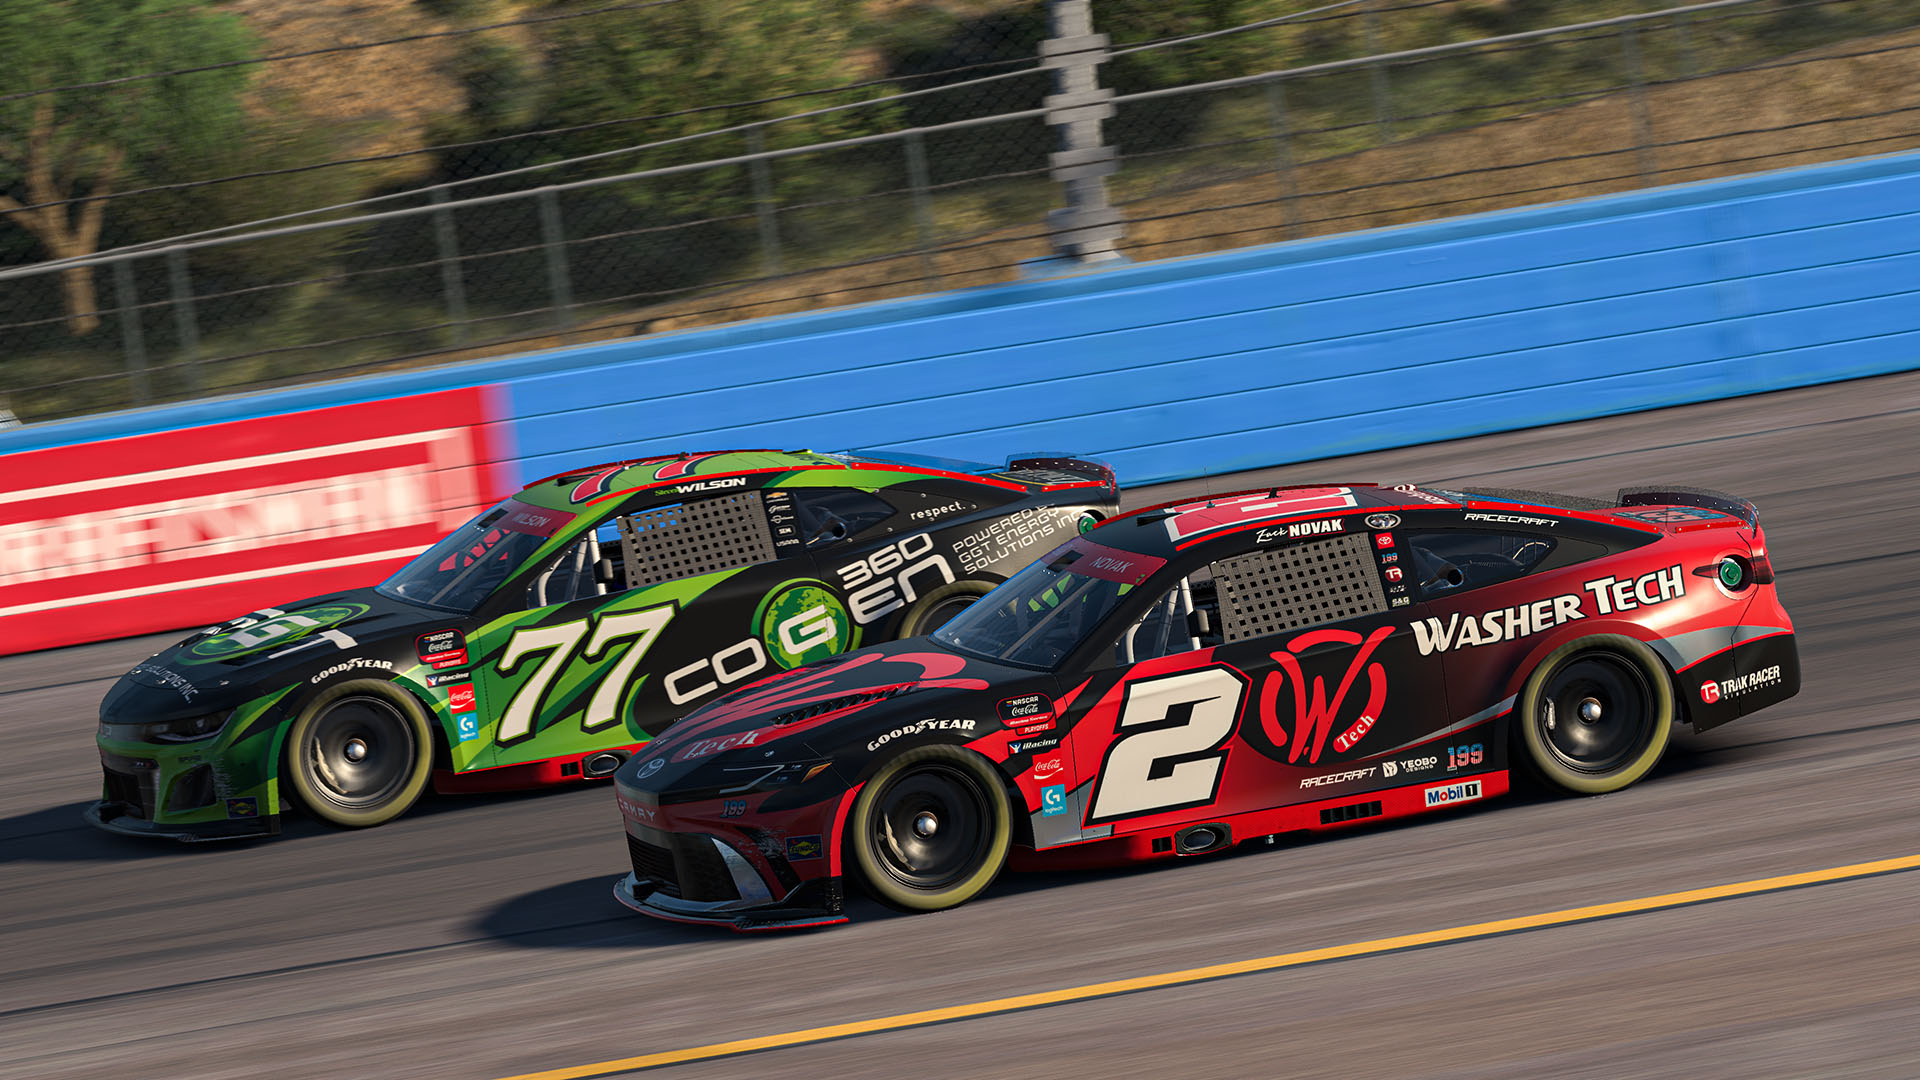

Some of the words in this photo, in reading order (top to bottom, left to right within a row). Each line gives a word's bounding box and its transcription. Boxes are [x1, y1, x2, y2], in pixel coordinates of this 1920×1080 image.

[676, 477, 747, 494] WILSON
[910, 501, 966, 520] respect.
[1464, 513, 1559, 528] RACECRAFT
[952, 508, 1033, 553] POWERED
[958, 540, 991, 564] GGT
[995, 507, 1059, 545] ENERGY
[1256, 527, 1288, 544] Zack
[1288, 518, 1344, 539] NOVAK
[836, 532, 934, 590] 360
[964, 526, 1055, 575] SOLUTIONS
[1089, 556, 1135, 573] NOVAK
[311, 657, 393, 684] GOODYEAR
[496, 602, 679, 746] 77
[1720, 674, 1748, 694] TRAK
[1749, 664, 1781, 687] RACER
[1012, 696, 1039, 706] NASCAR
[867, 718, 976, 752] GOODYEAR
[1024, 723, 1049, 733] PLAYOFFS
[1336, 712, 1376, 751] Tech
[682, 730, 759, 761] Tech
[1022, 738, 1058, 750] iRacing
[1087, 665, 1247, 823] 2
[1447, 743, 1484, 770] 199
[1399, 756, 1438, 769] YEOBO
[1300, 766, 1377, 790] RACECRAFT
[1427, 785, 1464, 805] Mobil
[719, 799, 747, 818] 199
